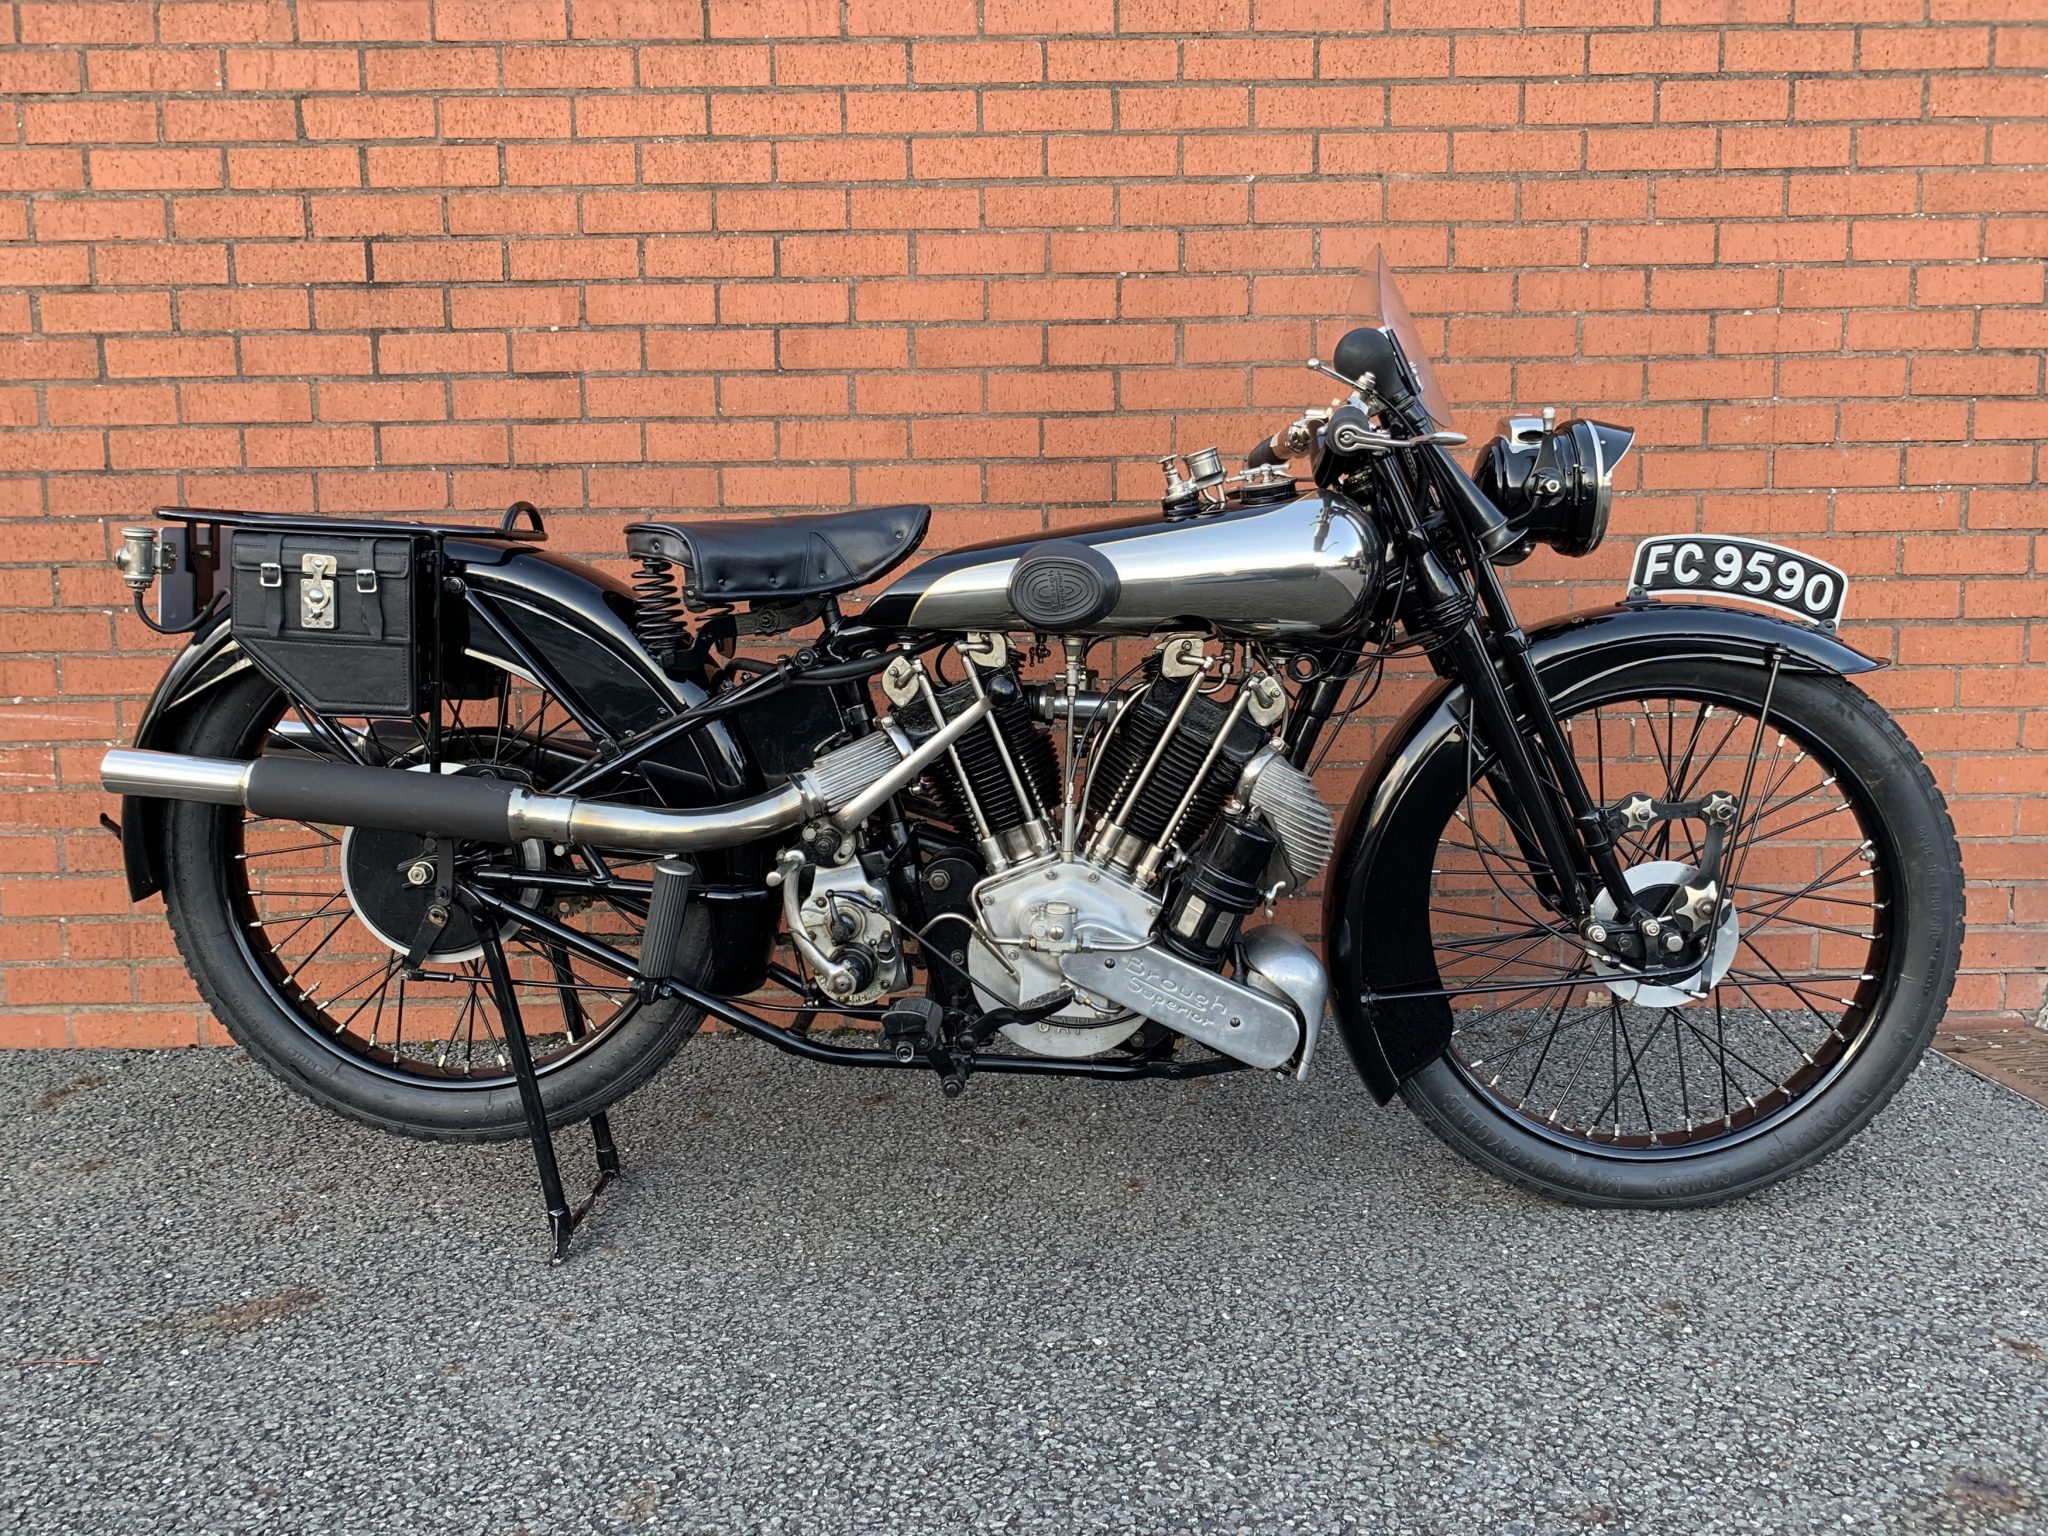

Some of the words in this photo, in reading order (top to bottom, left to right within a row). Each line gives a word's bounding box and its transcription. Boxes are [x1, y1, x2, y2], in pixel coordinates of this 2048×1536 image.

[1642, 542, 1704, 586] FC
[1711, 545, 1834, 612] 9590
[1124, 950, 1228, 1015] Brough
[1127, 974, 1215, 1028] Superior
